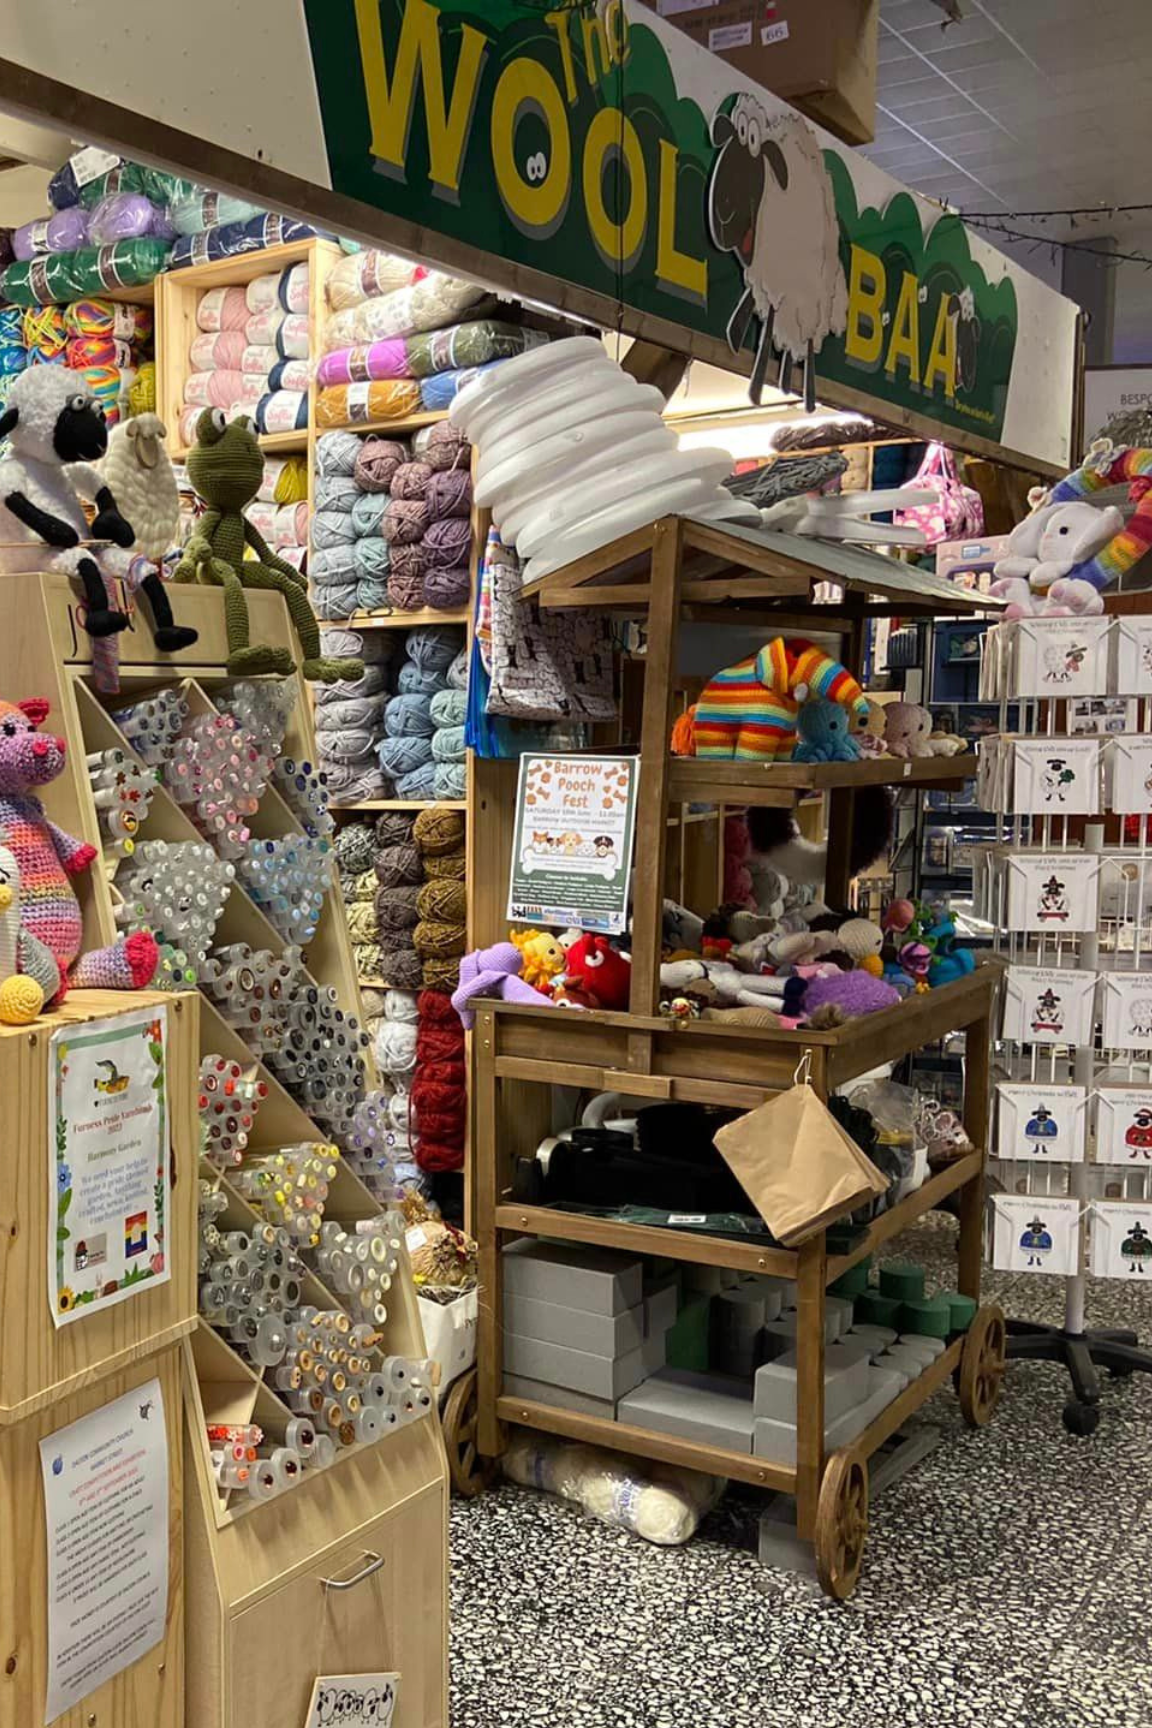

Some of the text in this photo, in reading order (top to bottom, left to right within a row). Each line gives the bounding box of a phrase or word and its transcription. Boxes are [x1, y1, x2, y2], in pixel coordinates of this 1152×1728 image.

[545, 0, 631, 104] The
[353, 0, 957, 399] WOOL BAA
[554, 761, 602, 775] Barrow
[558, 778, 595, 792] Pooch
[563, 794, 588, 808] Fest
